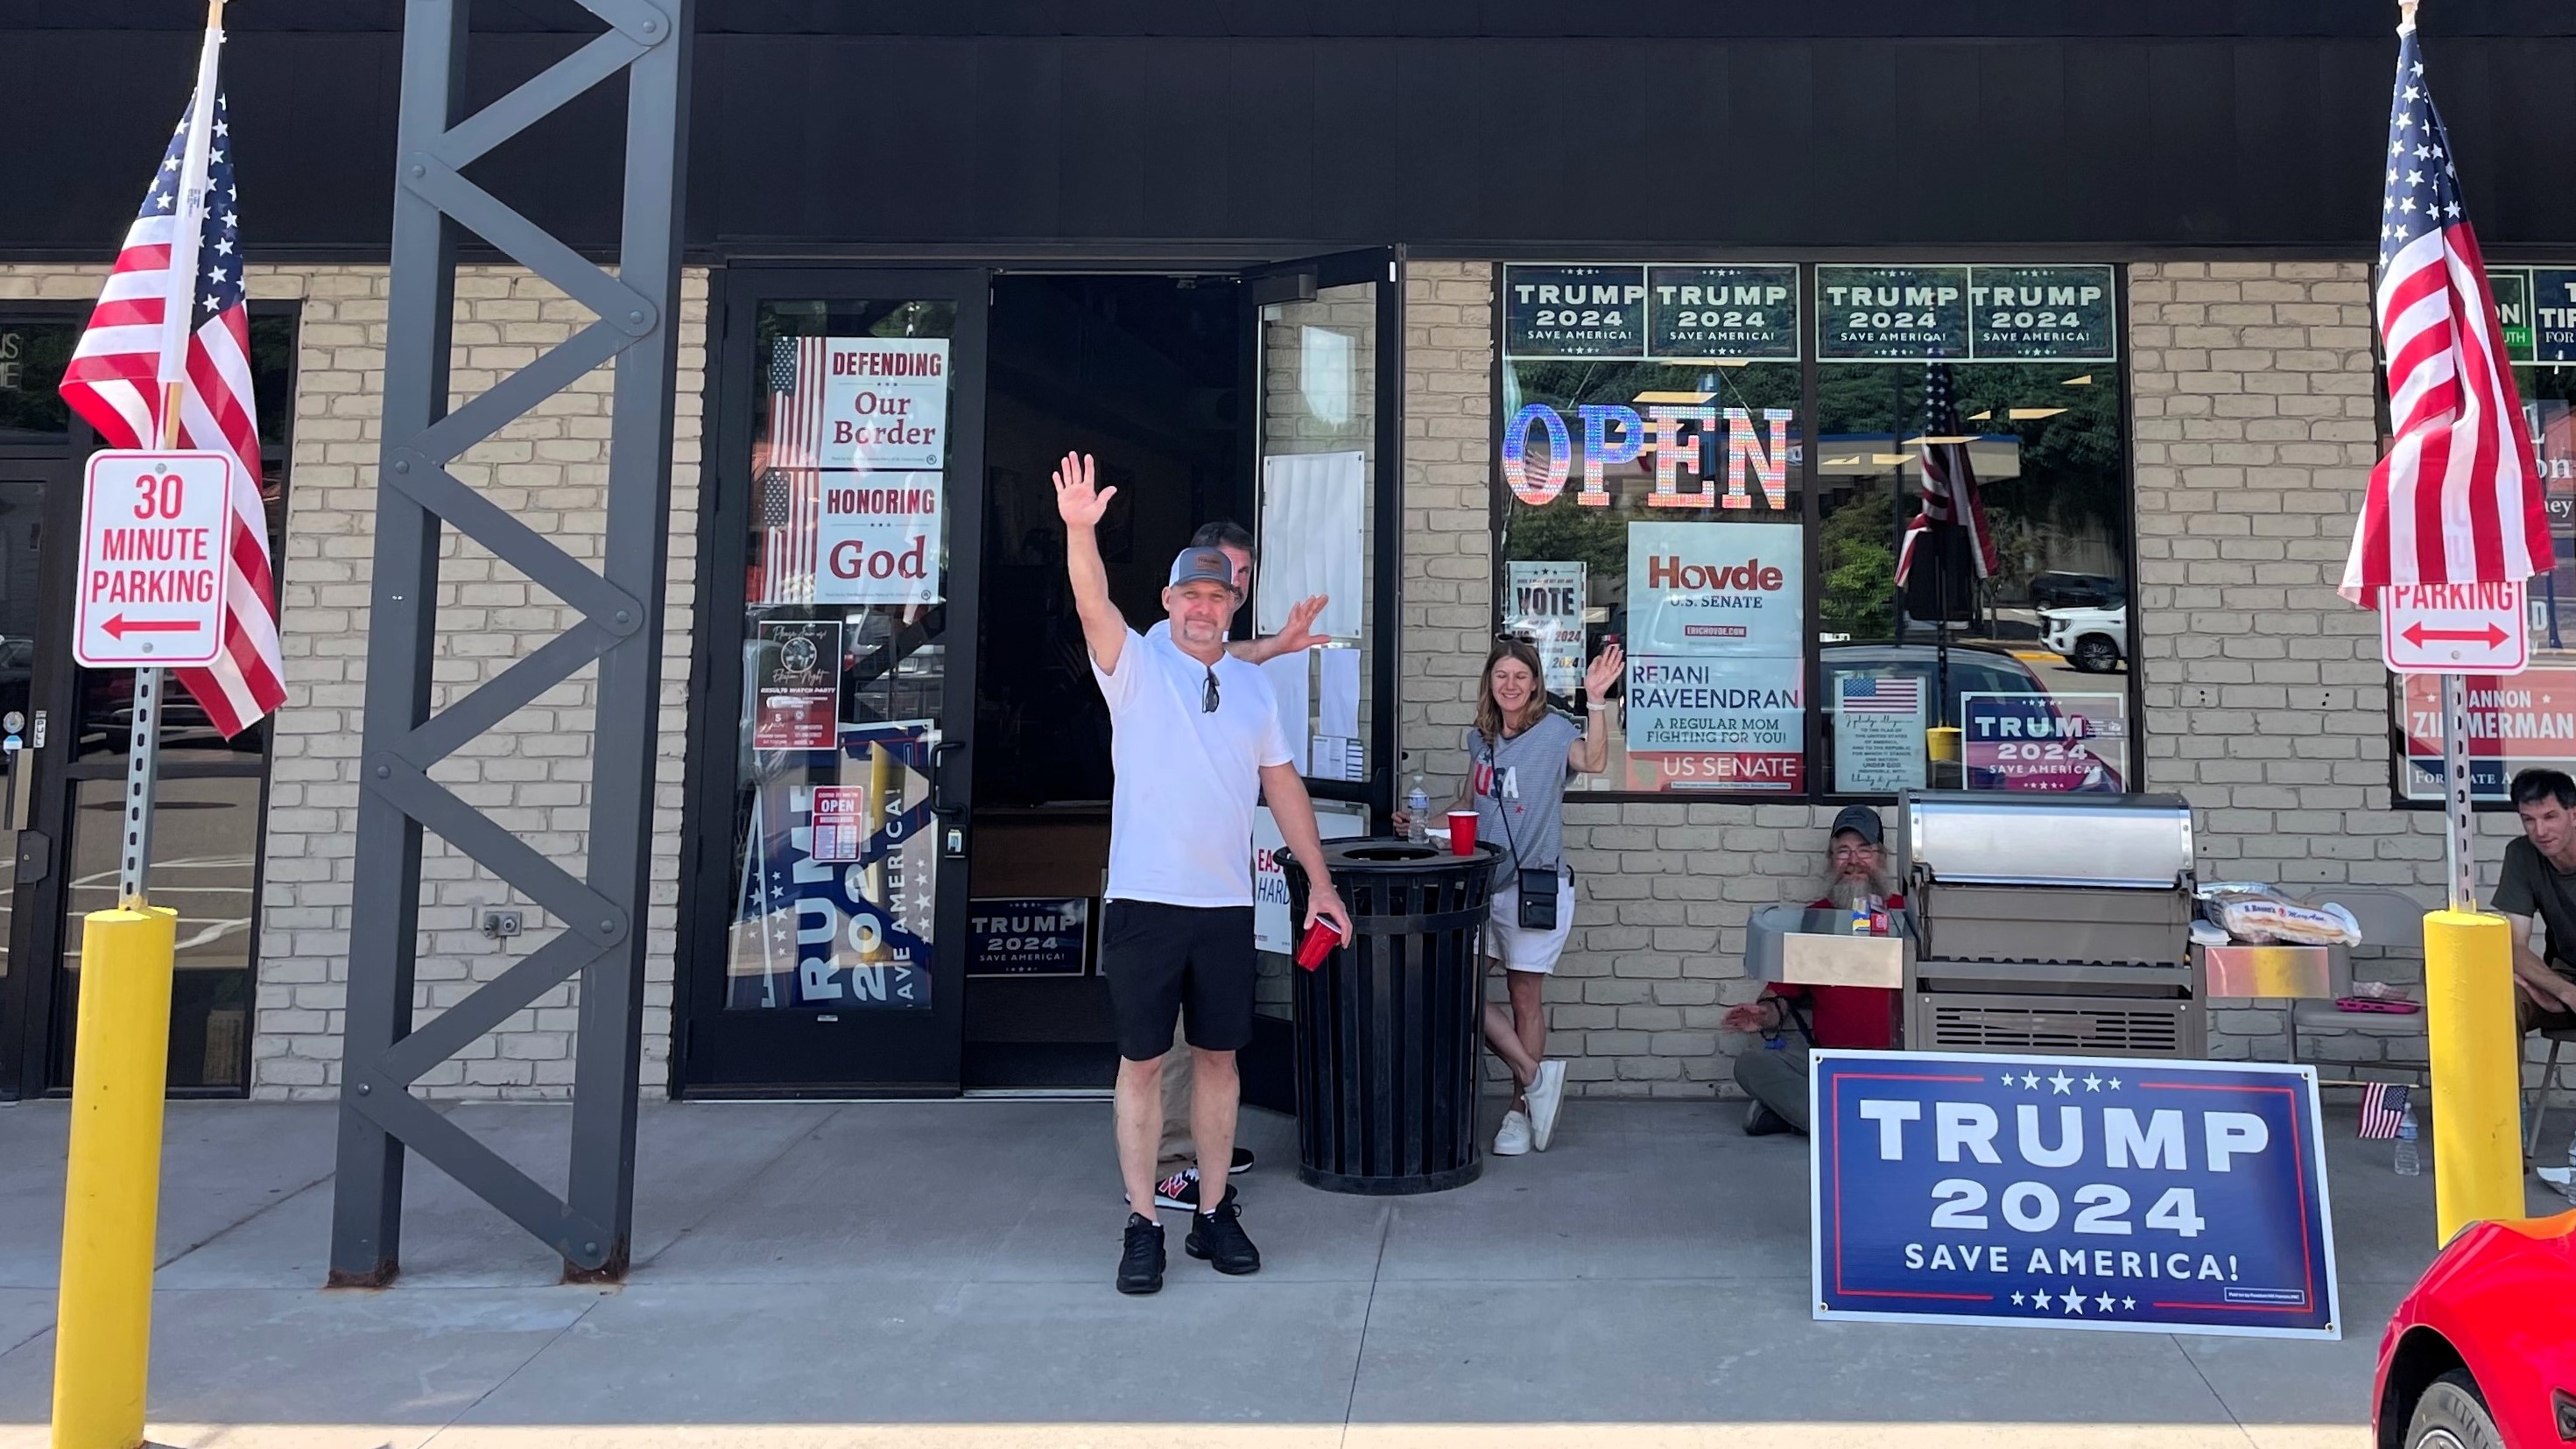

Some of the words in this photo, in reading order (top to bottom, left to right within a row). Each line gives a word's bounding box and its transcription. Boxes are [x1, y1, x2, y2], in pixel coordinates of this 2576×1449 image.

[1515, 285, 1643, 305] TRUMP
[1657, 285, 1787, 306] TRUMP
[1826, 286, 1959, 306] TRUMP
[1972, 286, 2101, 306] TRUMP
[1536, 310, 1622, 327] 2024
[1678, 311, 1765, 327] 2024
[1848, 312, 1937, 328] 2024
[1991, 312, 2080, 328] 2024
[1528, 330, 1561, 340] SAVE
[1566, 330, 1632, 340] AMERICA!
[1670, 331, 1704, 341] SAVE
[1707, 331, 1774, 341] AMERICA!
[1841, 332, 1875, 341] SAVE
[1879, 332, 1946, 342] AMERICA!
[1983, 332, 2017, 341] SAVE
[2022, 332, 2089, 342] AMERICA!
[2545, 332, 2574, 343] FOR
[833, 352, 941, 376] DEFENDING
[855, 391, 911, 416] Our
[833, 419, 936, 445] Border
[1503, 403, 1793, 510] OPEN
[134, 475, 182, 519] 30
[827, 489, 934, 515] HONORING
[102, 529, 208, 561] MINUTE
[829, 535, 928, 580] God
[1649, 556, 1783, 592] Hovde
[91, 569, 214, 603] PARKING
[2395, 582, 2513, 610] PARKING
[1517, 587, 1574, 615] VOTE
[1670, 595, 1698, 608] U.S.
[1701, 595, 1763, 609] SENATE
[1554, 630, 1581, 643] 2024
[1686, 626, 1745, 636] ERICHOVDE.COM
[1552, 658, 1579, 668] 2024
[1632, 665, 1709, 685] REJANI
[1631, 689, 1798, 709] RAVEENDRAN
[2468, 690, 2531, 708] ANNON
[35, 720, 45, 746] PULL
[1653, 718, 1665, 729] A
[1670, 719, 1738, 730] REGULAR
[1742, 719, 1779, 730] MOM
[2412, 711, 2573, 739] ZIMERMAN
[1646, 731, 1717, 743] FIGHTING
[1721, 732, 1749, 743] FOR
[1753, 733, 1786, 744] YOU!
[1997, 743, 2087, 760] 2024
[1664, 757, 1696, 777] US
[1702, 757, 1798, 777] SENATE
[1988, 764, 2023, 774] SAVE
[1475, 763, 1519, 798] USA
[821, 799, 854, 812] OPEN
[884, 789, 909, 934] AMERICA!
[972, 916, 1076, 933] TRUMP
[988, 937, 1058, 951] 2024
[893, 946, 914, 1007] AVE
[1859, 1099, 2269, 1172] TRUMP
[1930, 1178, 2206, 1238] 2024
[1904, 1242, 2009, 1273] SAVE
[2027, 1248, 2240, 1282] AMERICA!
